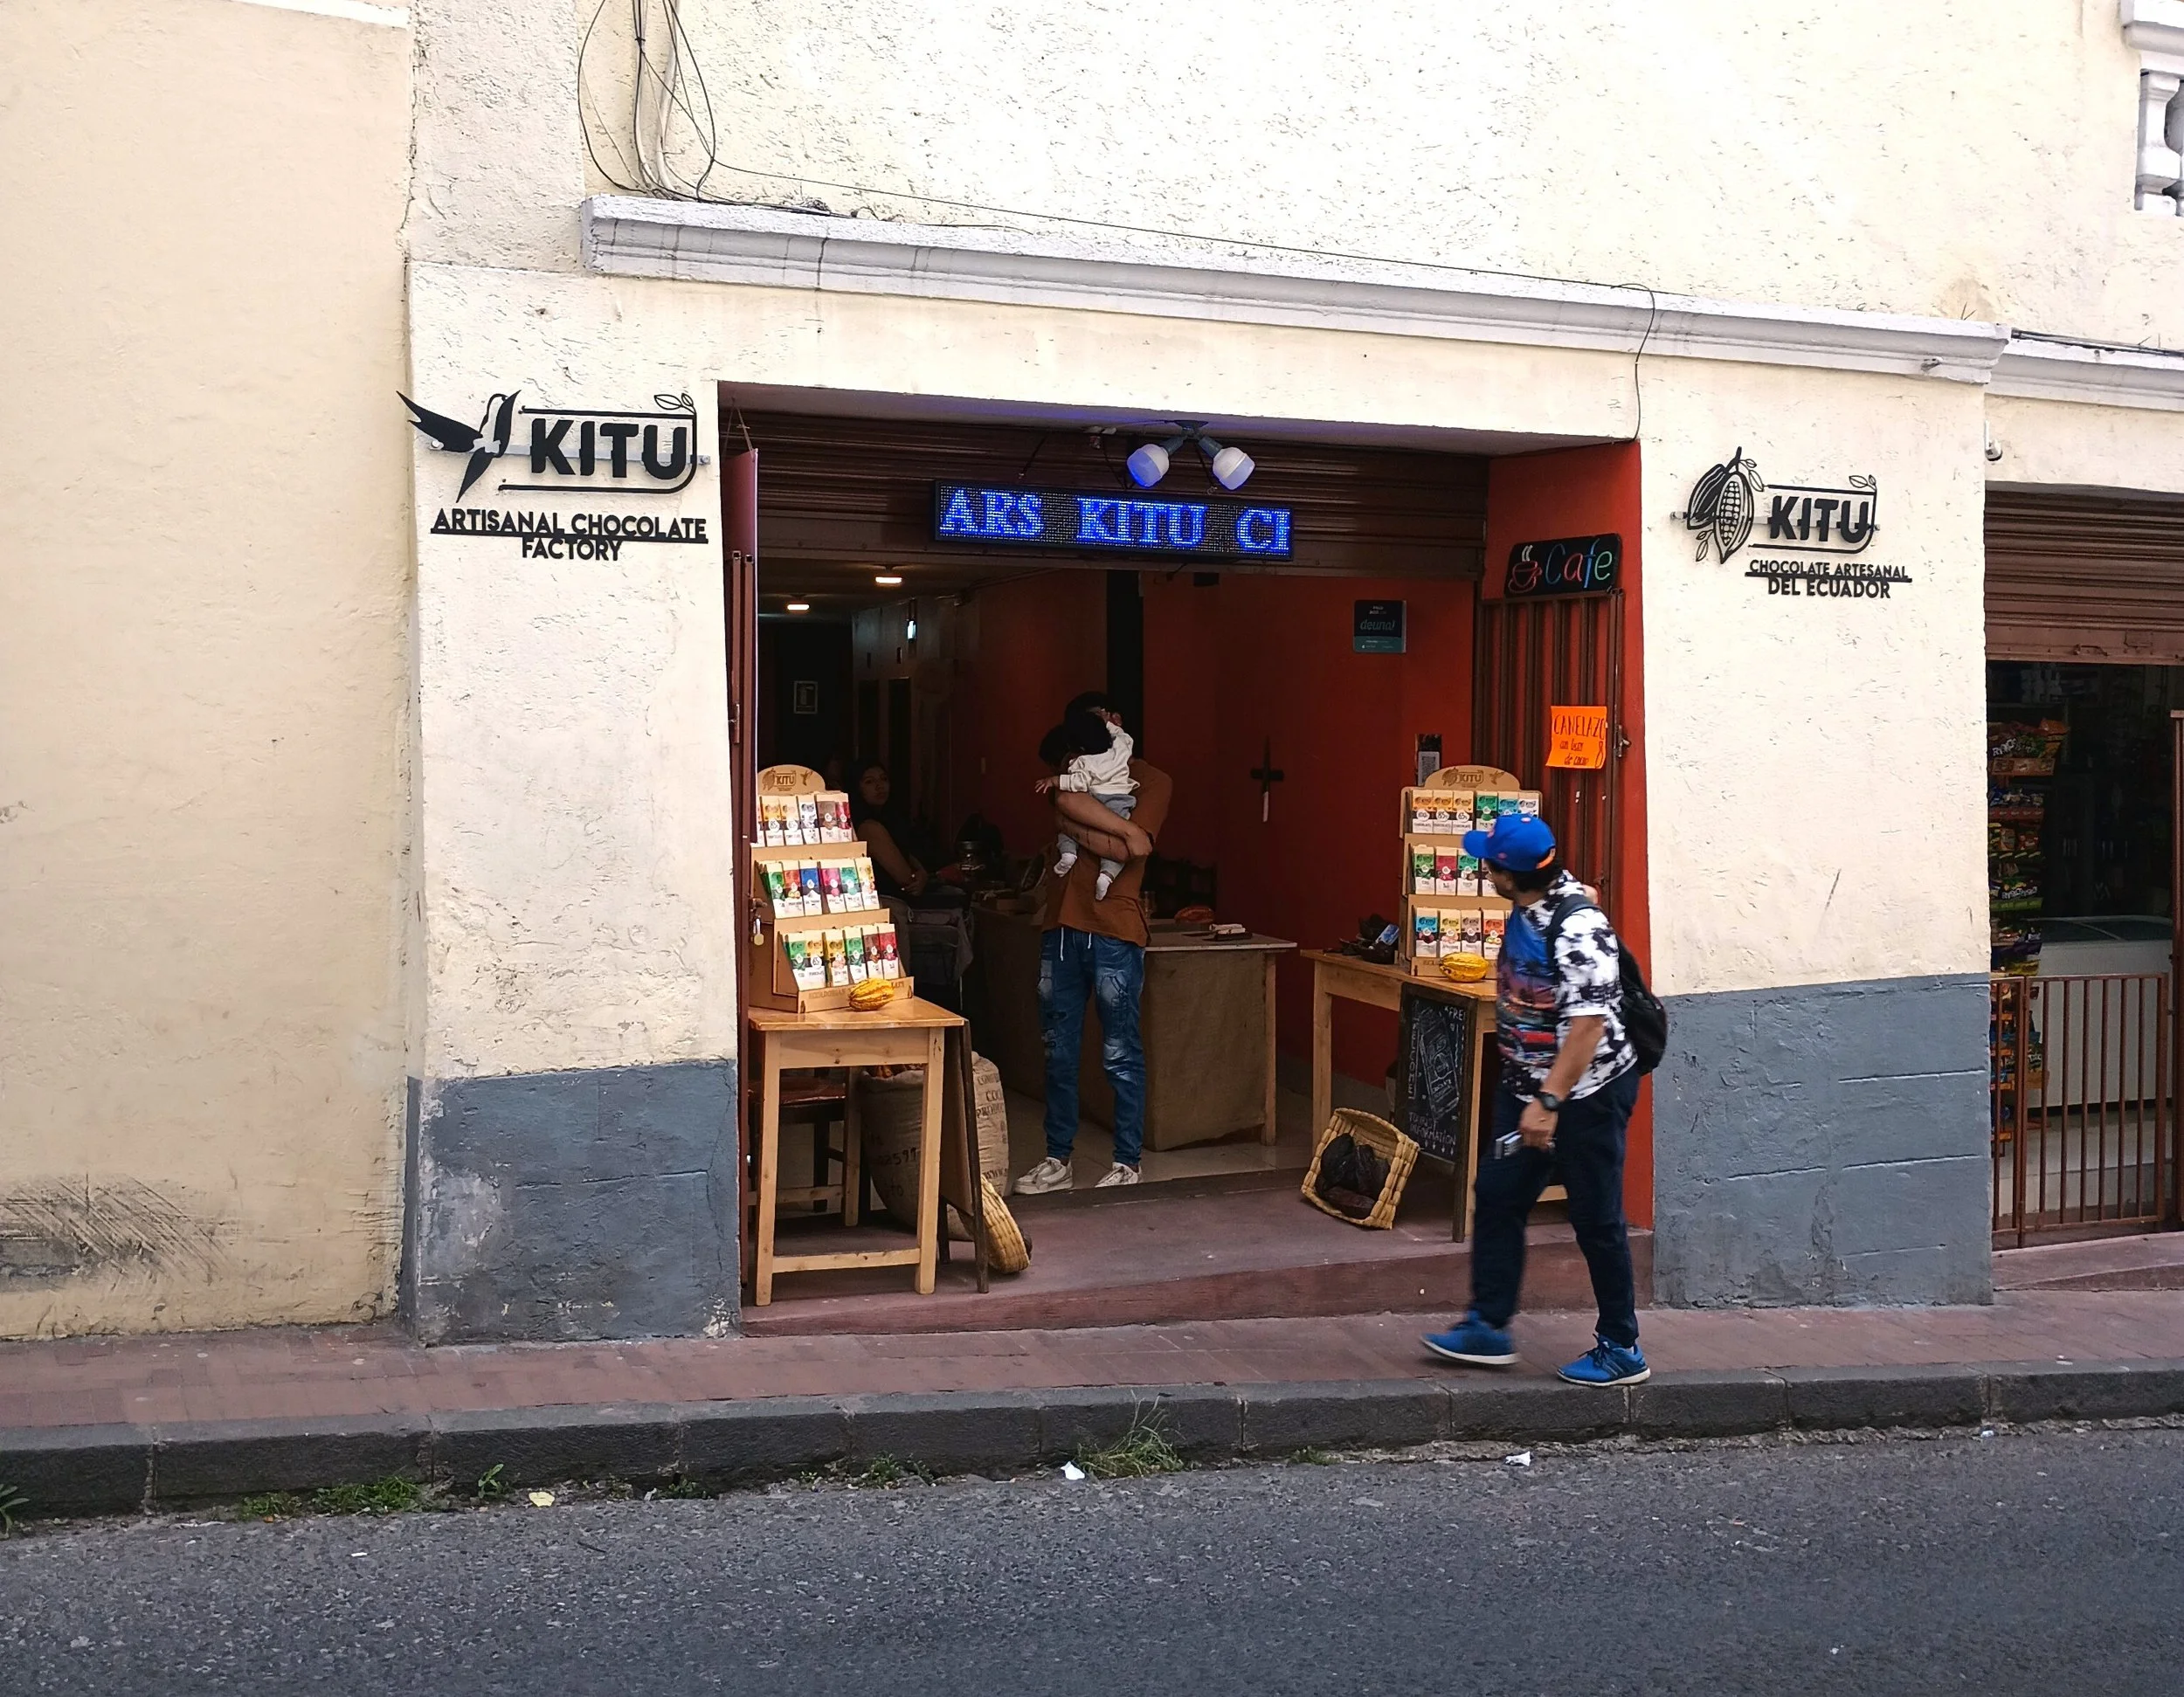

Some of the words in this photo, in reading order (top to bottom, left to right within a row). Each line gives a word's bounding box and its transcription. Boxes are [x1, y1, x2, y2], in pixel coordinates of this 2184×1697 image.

[530, 418, 687, 479] KITU
[434, 507, 565, 535] ARTISANAL
[571, 513, 707, 541] CHOCOLATE
[939, 489, 1043, 536] ARS
[1075, 497, 1209, 546] KITU
[1768, 495, 1870, 543] KITU
[522, 536, 623, 562] FACTORY
[1545, 537, 1613, 589] Cafe
[1750, 559, 1829, 576] CHOCOLATE
[1835, 562, 1909, 579] ARTESANAL
[1768, 577, 1800, 596] DEL
[1807, 579, 1890, 598] ECUADOR
